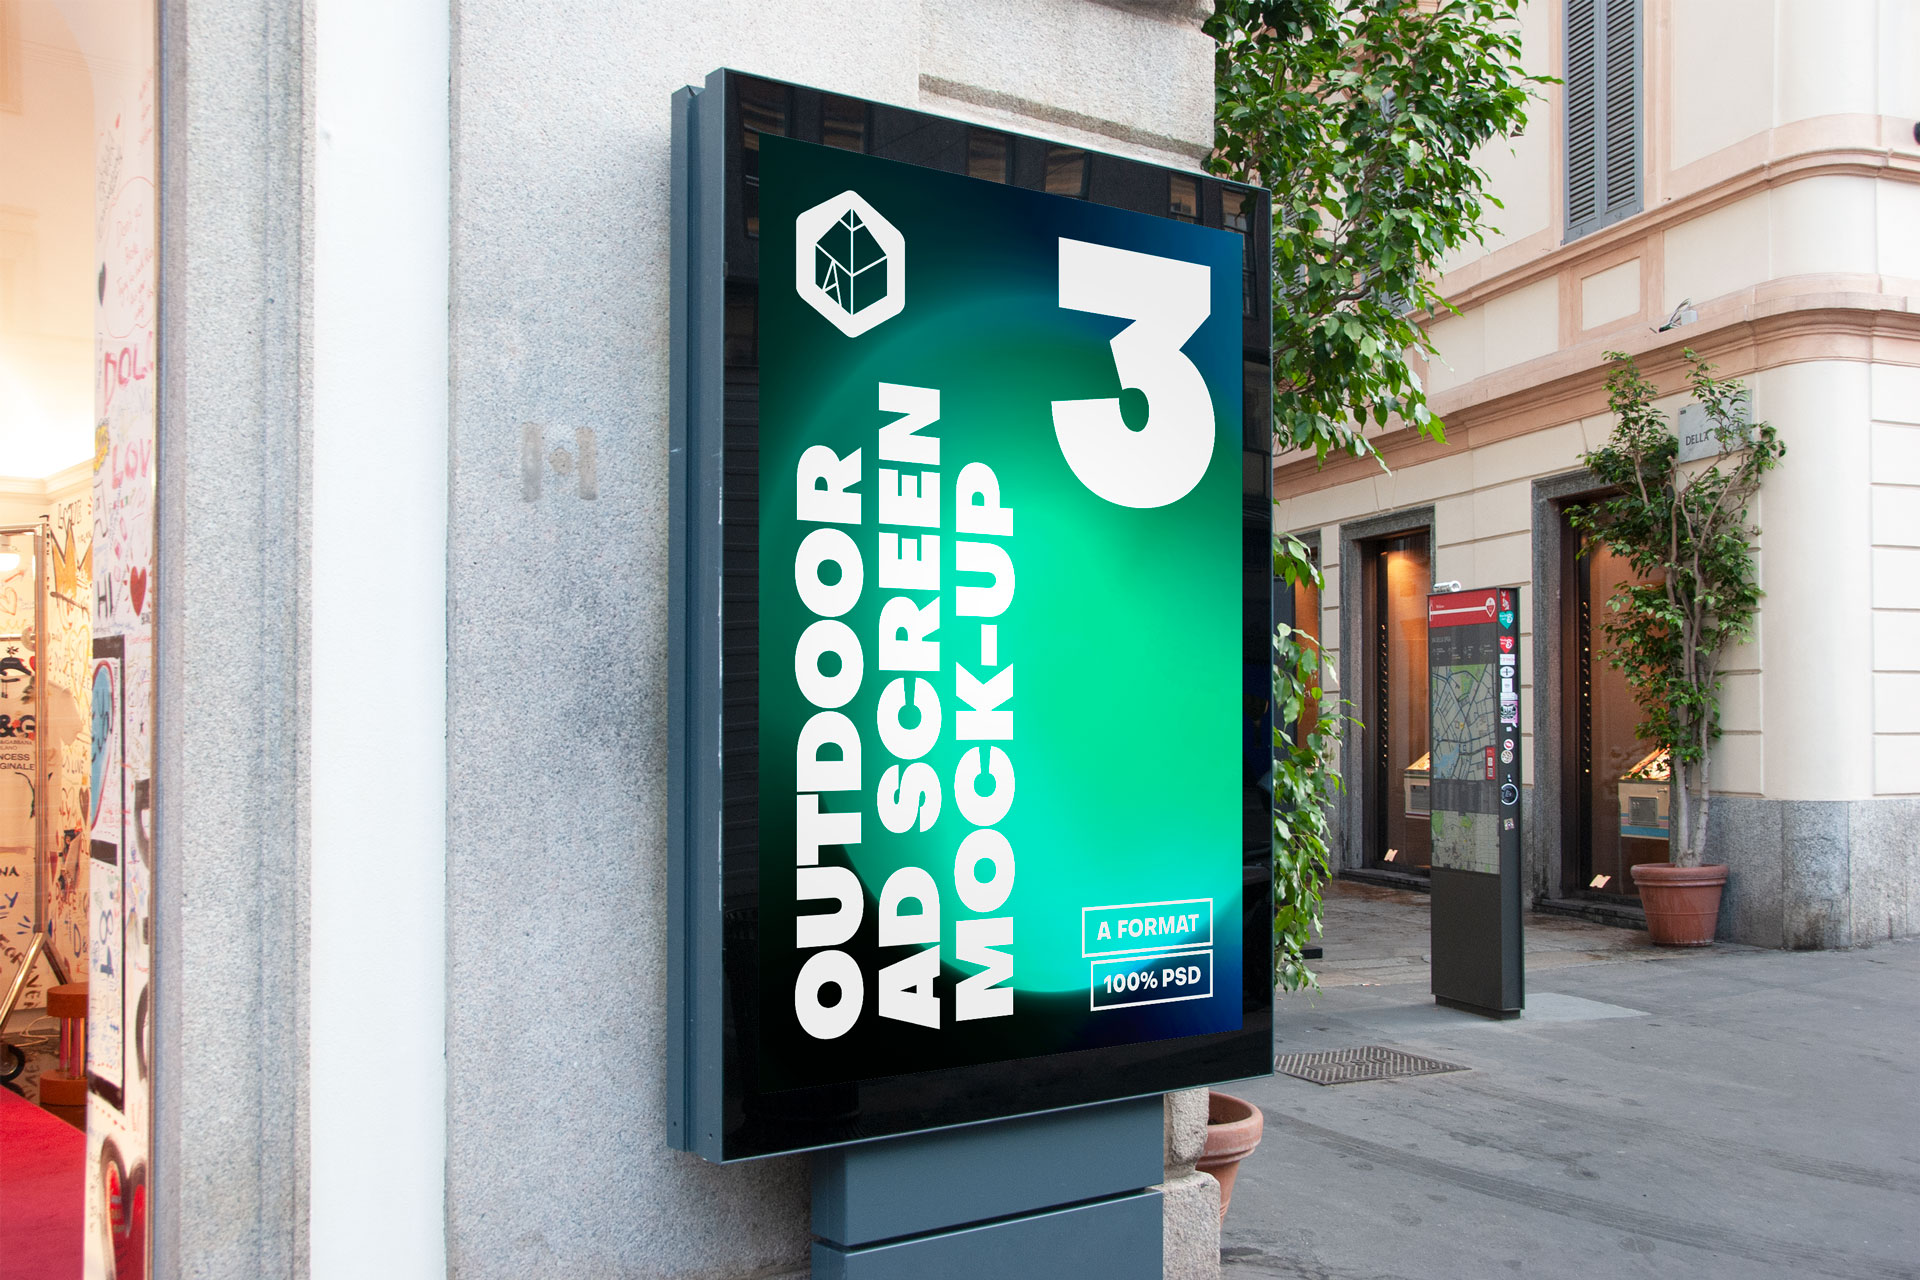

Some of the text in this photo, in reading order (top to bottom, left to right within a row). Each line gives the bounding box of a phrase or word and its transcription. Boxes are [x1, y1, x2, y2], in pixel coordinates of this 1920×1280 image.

[1051, 236, 1216, 509] 3
[1685, 431, 1709, 446] DELLA
[794, 445, 864, 1040] OUTDOOR
[876, 382, 942, 1030] AD SCREEN
[953, 461, 1016, 1022] MOCK-UP
[1096, 913, 1200, 941] A FORMAT
[1103, 965, 1202, 994] 100% PSD
